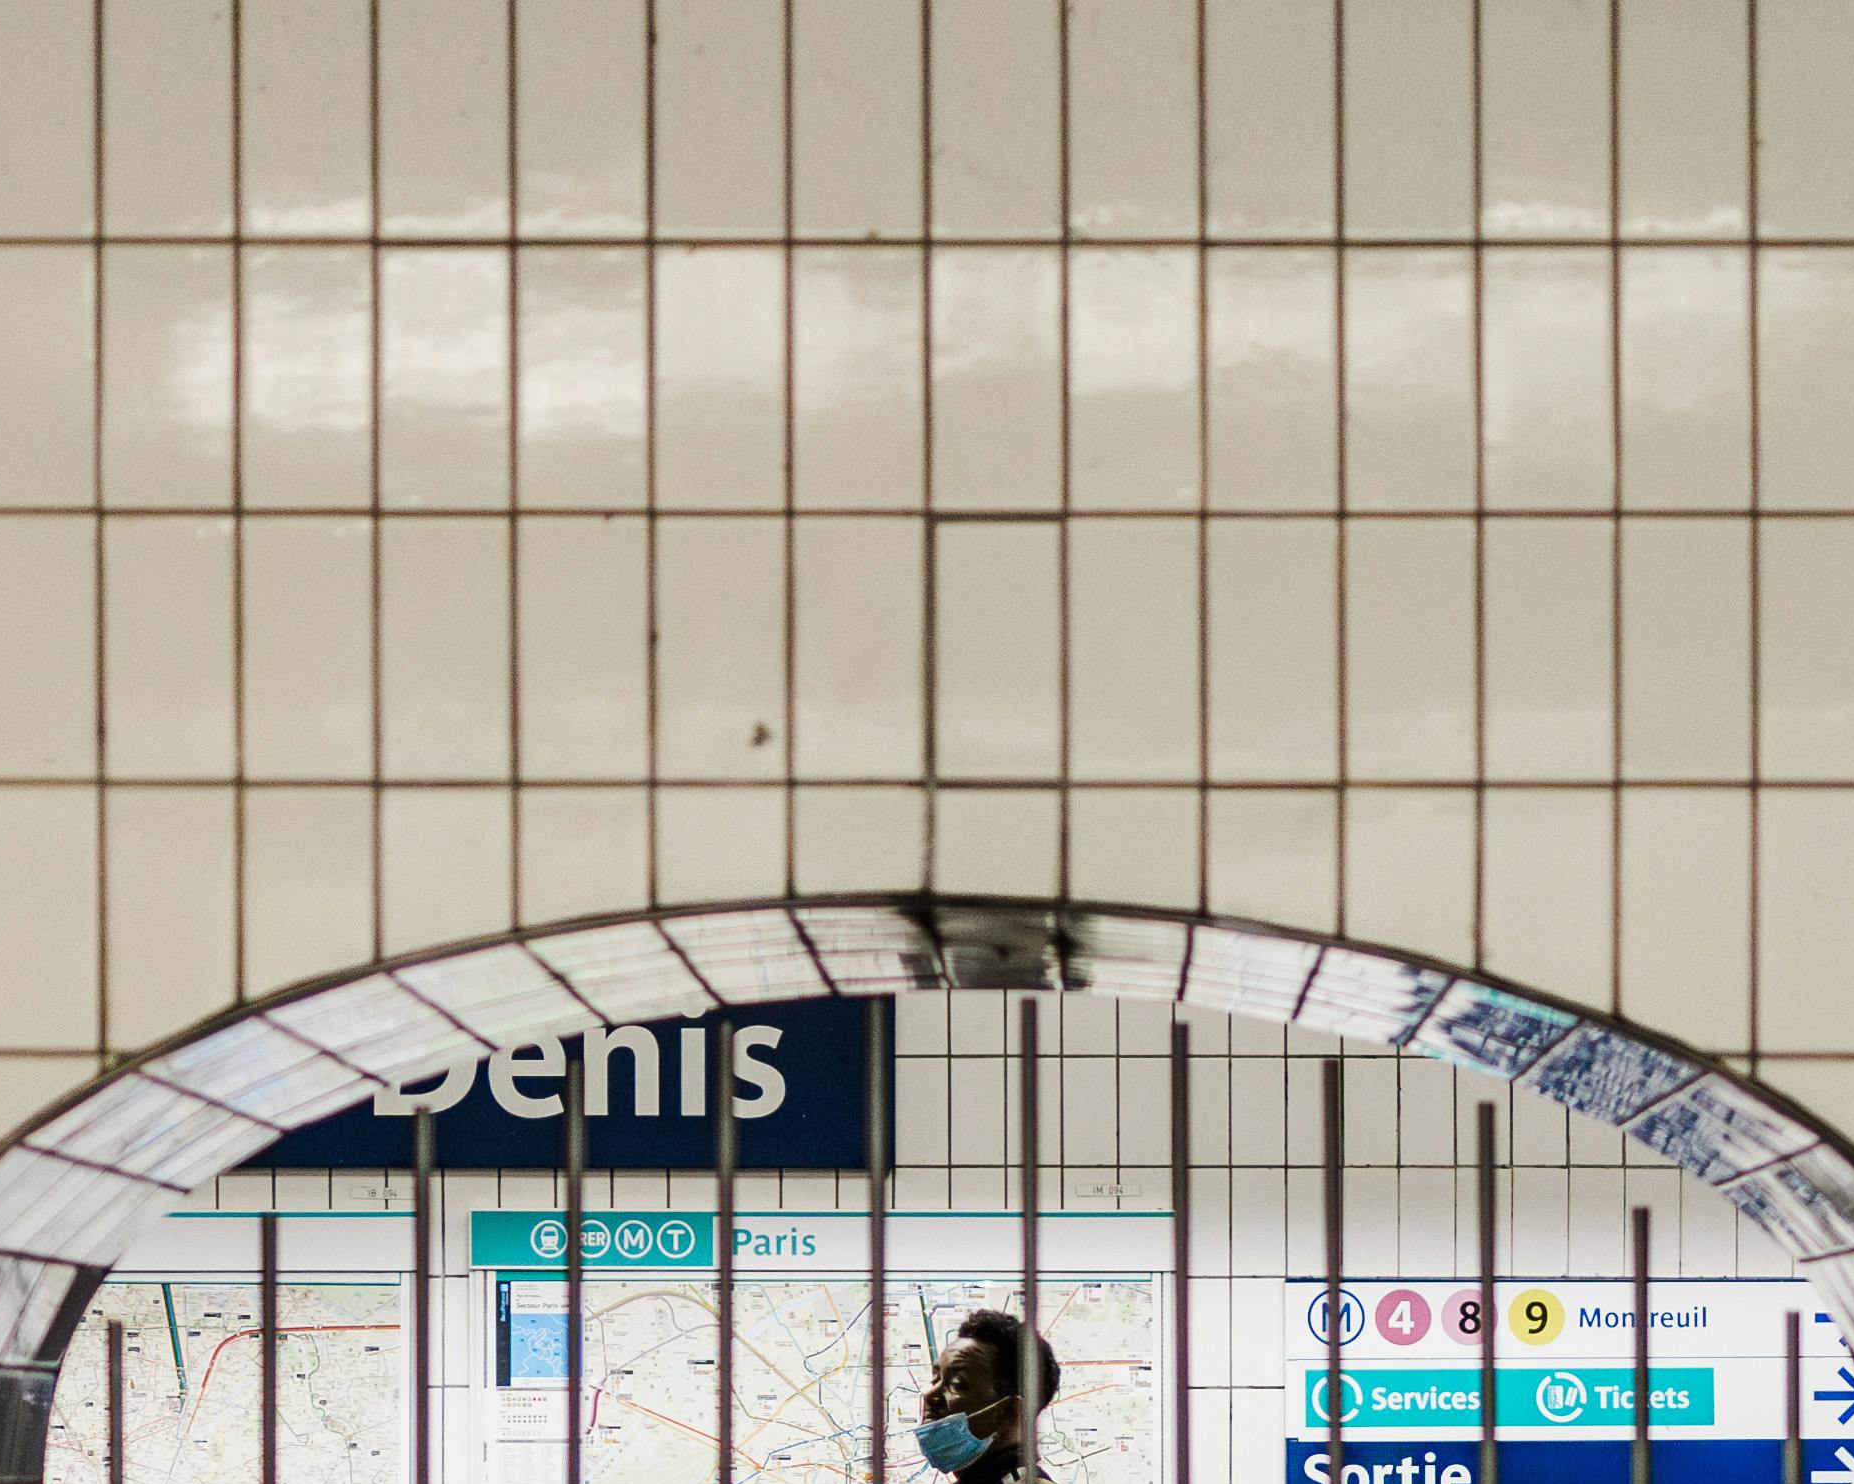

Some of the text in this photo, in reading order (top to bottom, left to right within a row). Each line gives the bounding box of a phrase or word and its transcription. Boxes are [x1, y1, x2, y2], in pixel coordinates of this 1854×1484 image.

[732, 1227, 816, 1256] Paris
[1388, 1300, 1415, 1335] 4
[1458, 1300, 1482, 1335] 8
[1525, 1301, 1548, 1334] 9
[1579, 1306, 1707, 1328] Monreuil
[1371, 1384, 1690, 1411] Services Ticets
